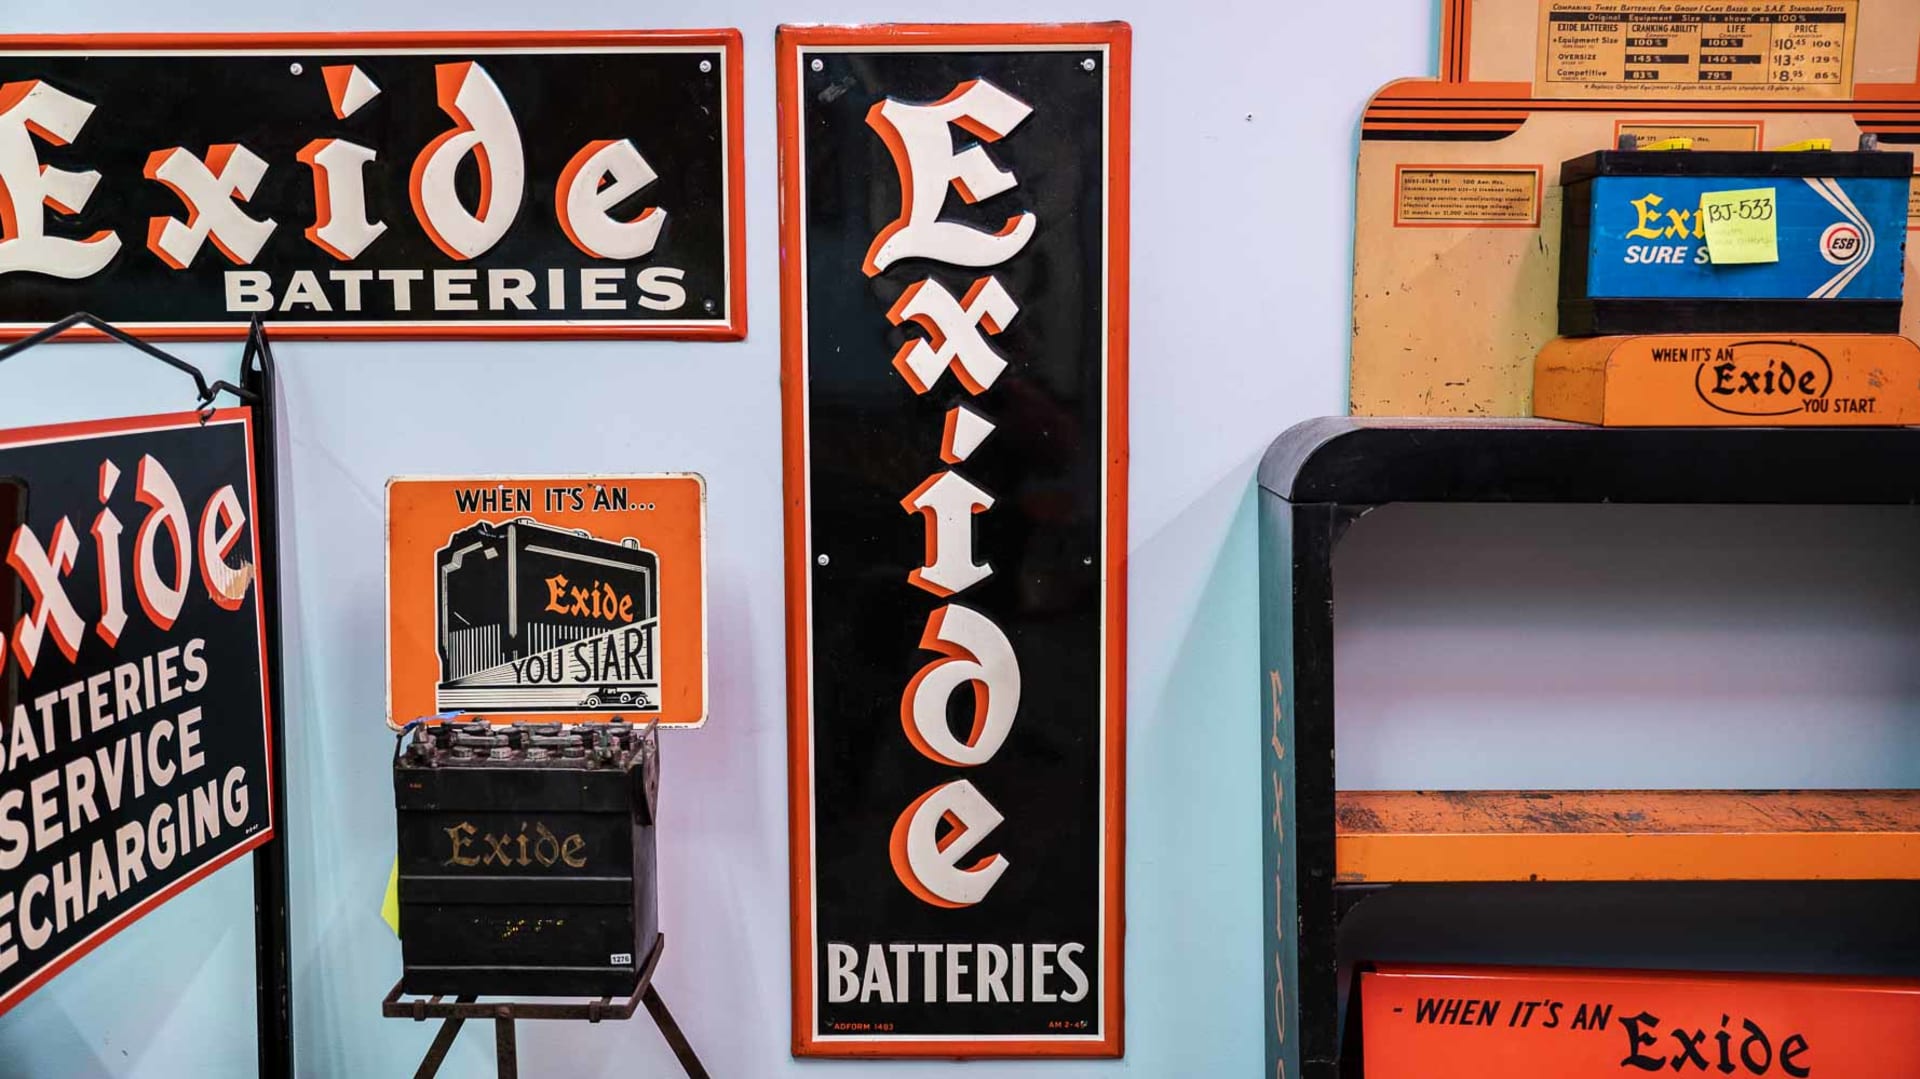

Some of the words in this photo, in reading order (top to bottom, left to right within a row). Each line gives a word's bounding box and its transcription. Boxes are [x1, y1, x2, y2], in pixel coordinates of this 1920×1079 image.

[1558, 24, 1577, 32] EXIDE
[1580, 24, 1618, 32] BATTERIES
[1588, 13, 1621, 22] Original
[1628, 14, 1672, 23] Equipment
[1632, 24, 1668, 33] CRANKING
[1670, 24, 1698, 33] ABILITY
[1727, 25, 1745, 33] LIFE
[1795, 25, 1818, 33] PRICE
[0, 61, 667, 280] Exide
[1625, 193, 1705, 239] Exi
[1708, 198, 1774, 223] BJ-533
[1624, 245, 1688, 264] SURE
[1832, 238, 1855, 250] ESB
[224, 267, 688, 313] BATTERIES
[1652, 348, 1688, 362] WHEN
[1691, 347, 1711, 362] IT'S
[1715, 348, 1734, 362] AN
[1712, 359, 1815, 395] Exide
[1802, 399, 1829, 413] YOU
[1834, 398, 1876, 413] START
[455, 488, 532, 513] WHEN
[545, 487, 584, 512] IT'S
[861, 78, 1038, 909] Exide
[0, 453, 250, 679] xide
[545, 574, 634, 622] Exide
[512, 649, 563, 684] YOU
[574, 624, 657, 683] START
[0, 637, 208, 778] ATTERIES
[0, 706, 204, 871] SERVICE
[443, 821, 588, 868] Exide
[827, 942, 1090, 1003] BATTERIES
[834, 1022, 871, 1031] ADFORM
[1048, 1021, 1063, 1029] AM
[1414, 998, 1501, 1027] WHEN
[1509, 999, 1564, 1029] IT'S
[1571, 1003, 1614, 1031] AN
[1619, 1011, 1811, 1078] Exide
